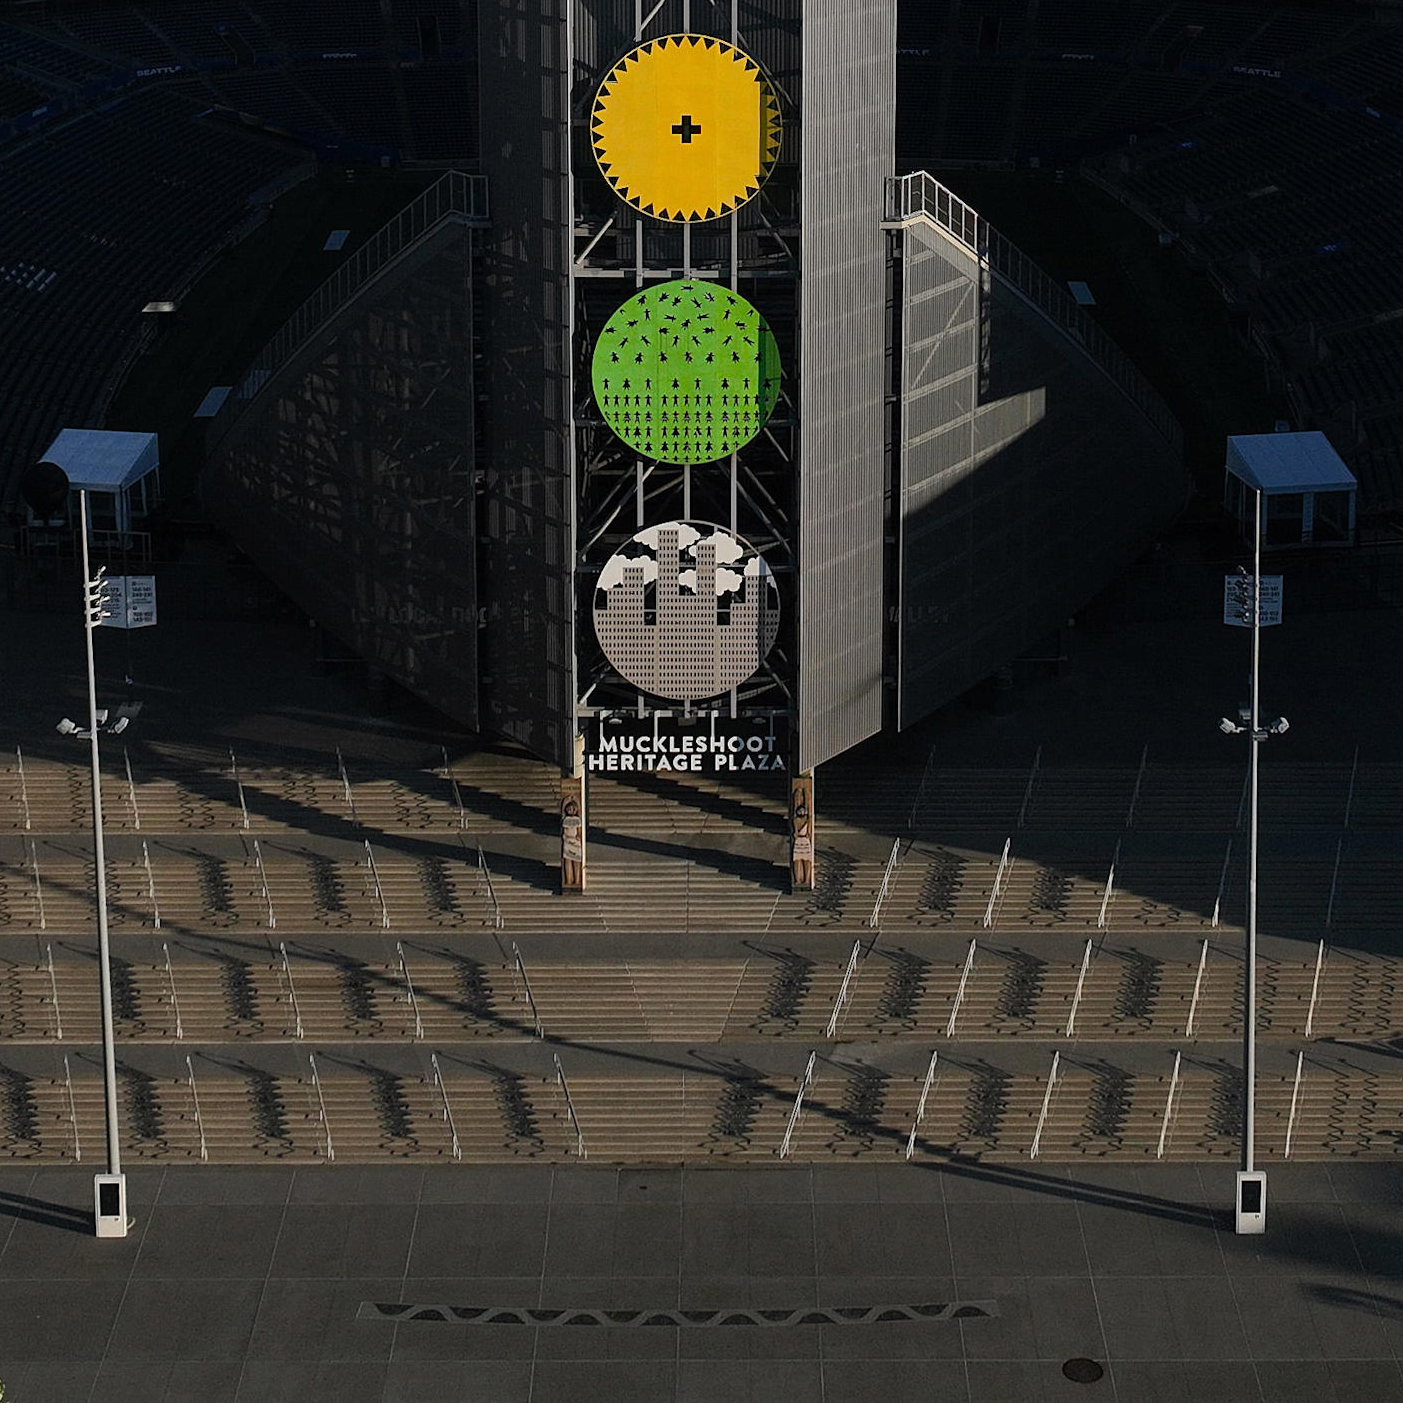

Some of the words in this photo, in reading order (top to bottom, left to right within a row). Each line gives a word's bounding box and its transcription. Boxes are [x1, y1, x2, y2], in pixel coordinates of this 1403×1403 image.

[598, 735, 776, 752] MUCKLESHOOT
[588, 753, 702, 771] HERITAGE
[714, 753, 786, 771] PLAZA
